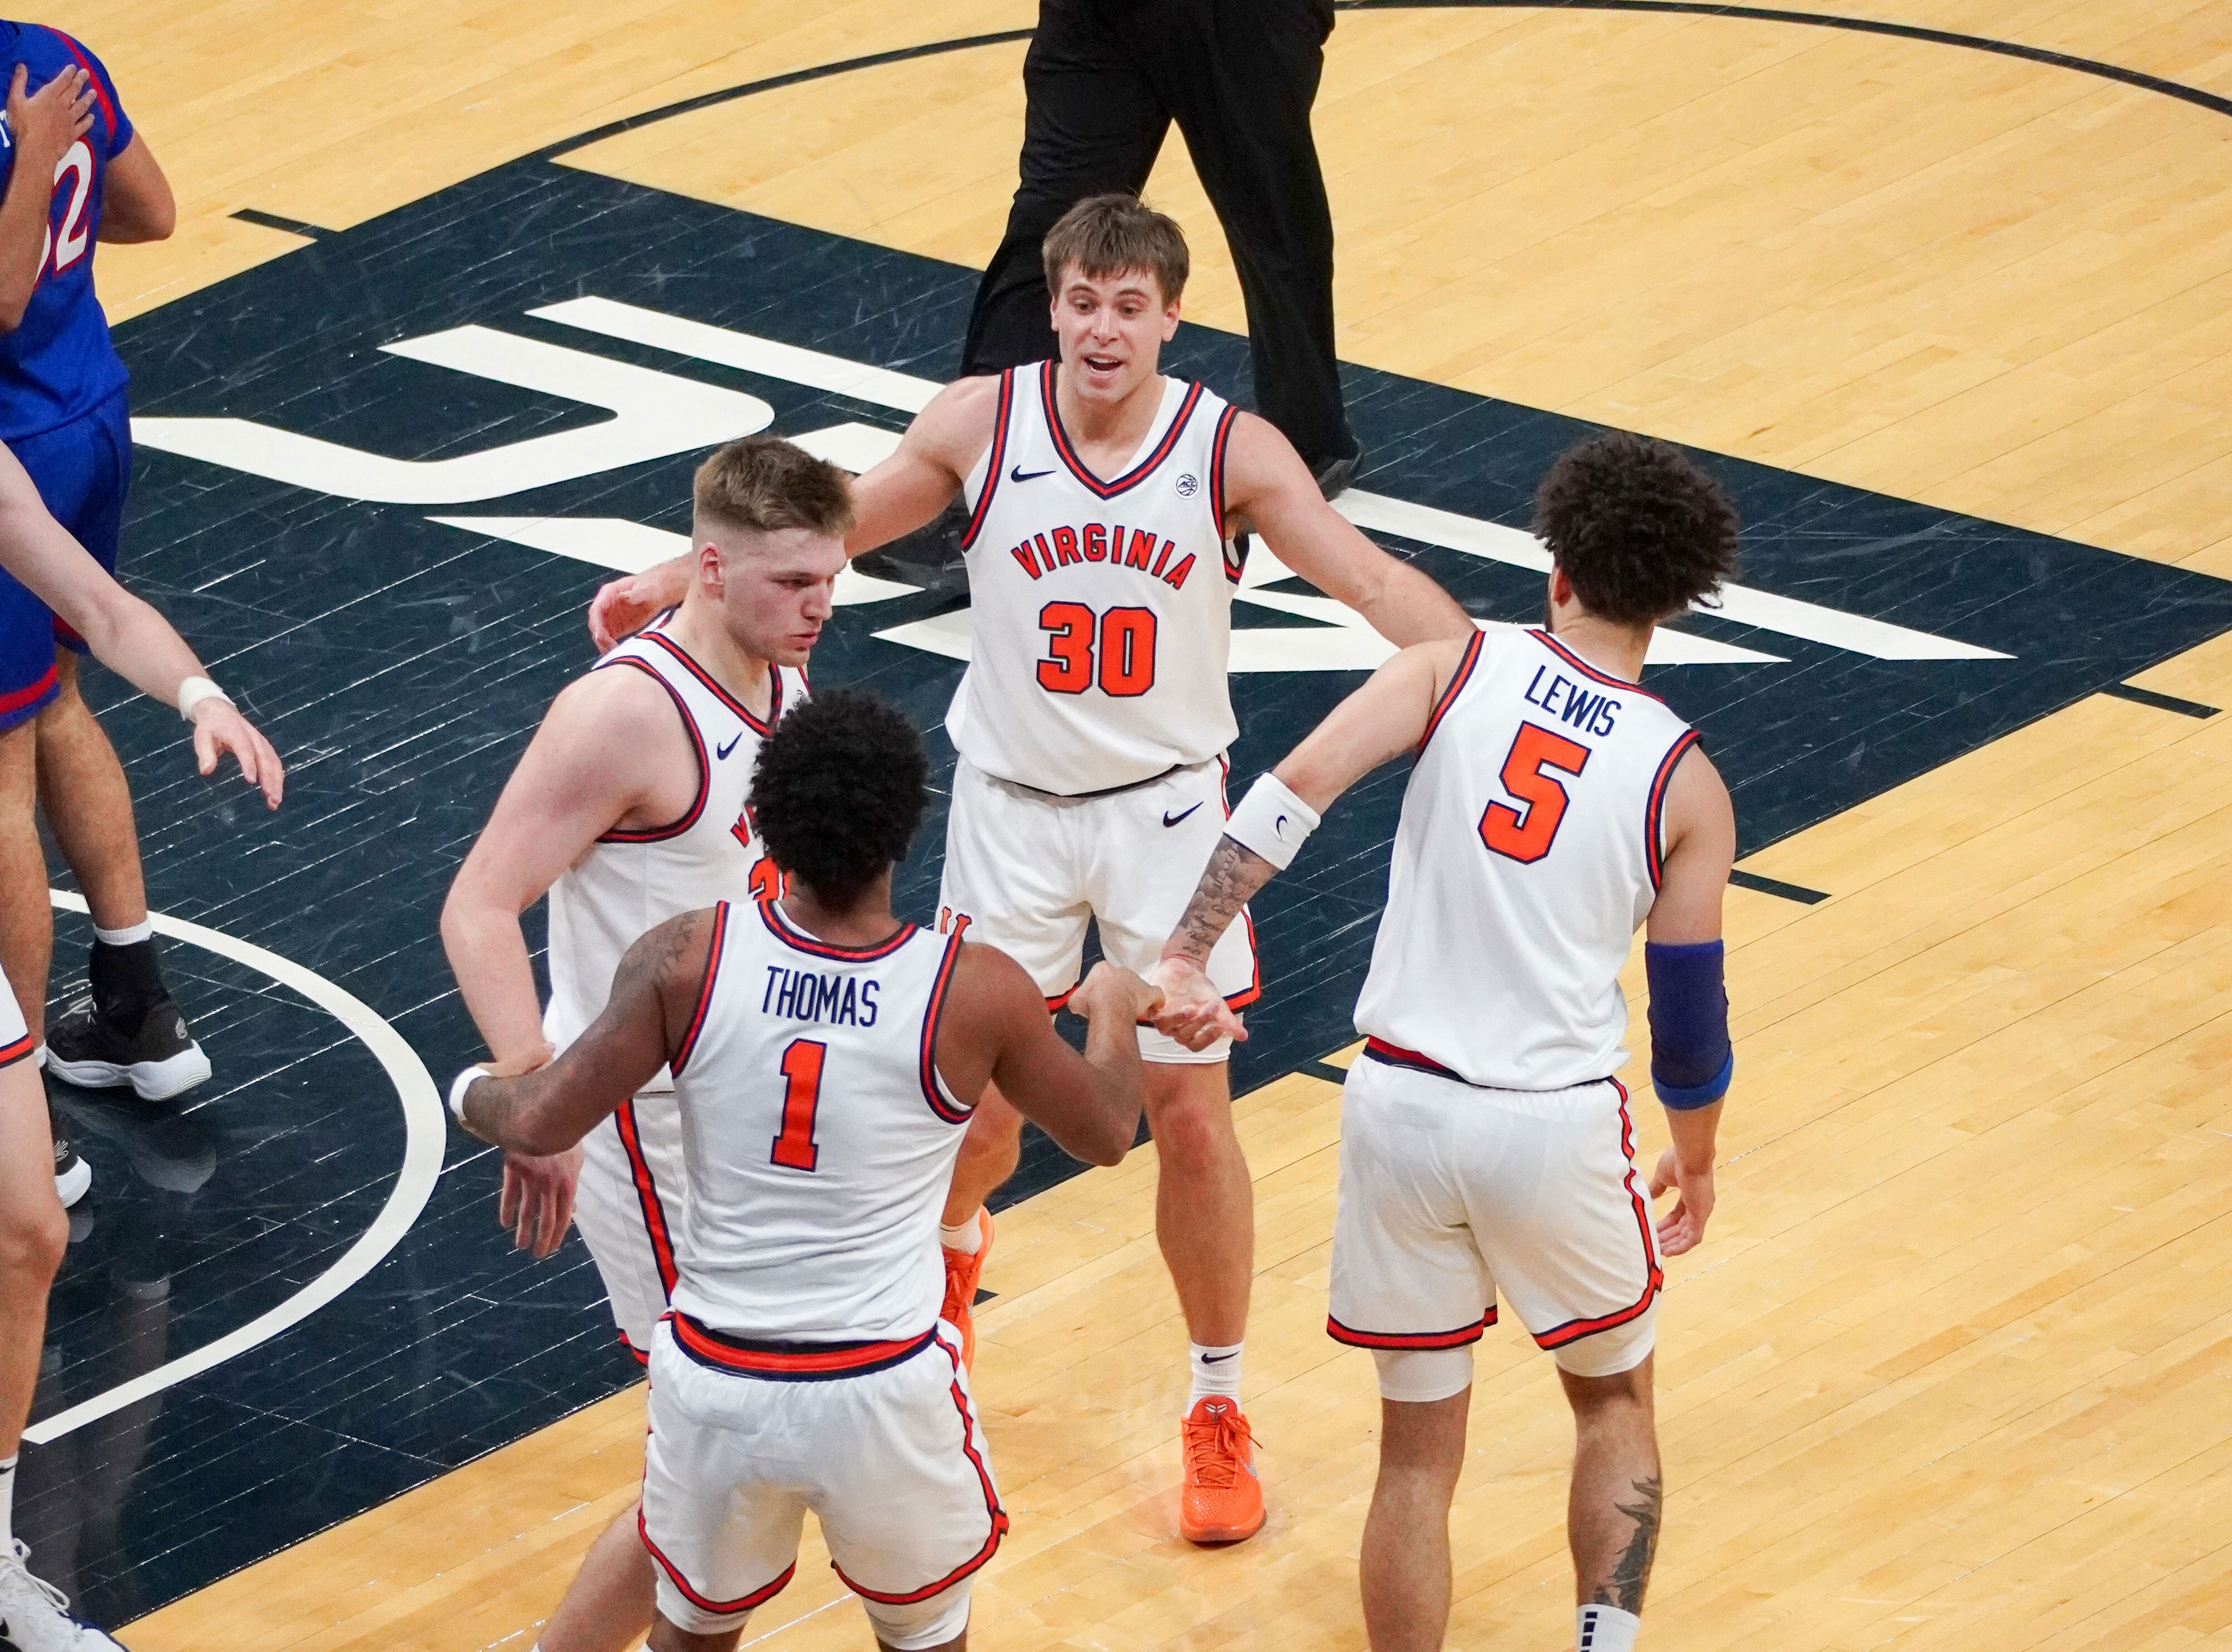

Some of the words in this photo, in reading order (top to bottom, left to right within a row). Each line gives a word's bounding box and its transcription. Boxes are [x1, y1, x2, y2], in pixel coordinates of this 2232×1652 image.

[34, 136, 95, 288] 2
[1011, 523, 1196, 590] VIRGINIA
[1037, 600, 1158, 697] 30
[1524, 665, 1622, 737] LEWIS
[1477, 720, 1592, 865] 5
[762, 966, 880, 1028] THOMAS
[770, 1038, 827, 1172] 1
